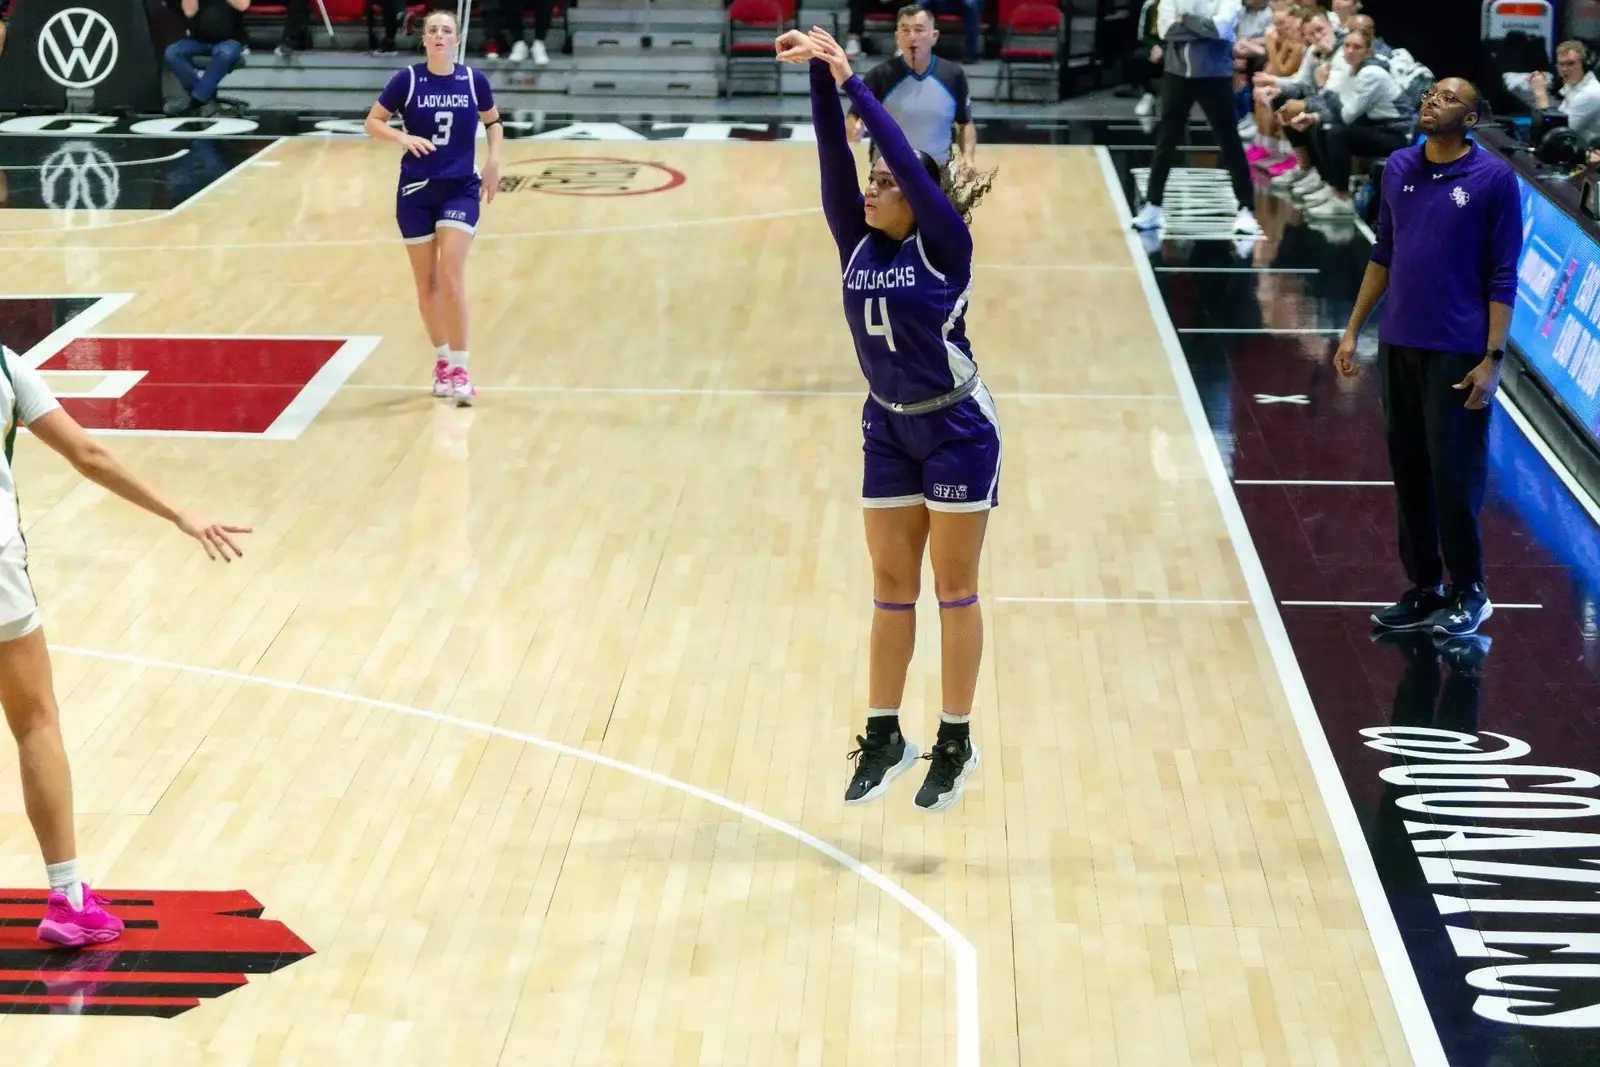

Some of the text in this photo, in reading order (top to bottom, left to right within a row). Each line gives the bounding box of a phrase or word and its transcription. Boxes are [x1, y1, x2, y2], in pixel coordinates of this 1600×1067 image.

[417, 94, 469, 108] LADYJACKS
[0, 114, 259, 136] GO
[432, 111, 453, 145] 3
[864, 297, 897, 352] 4
